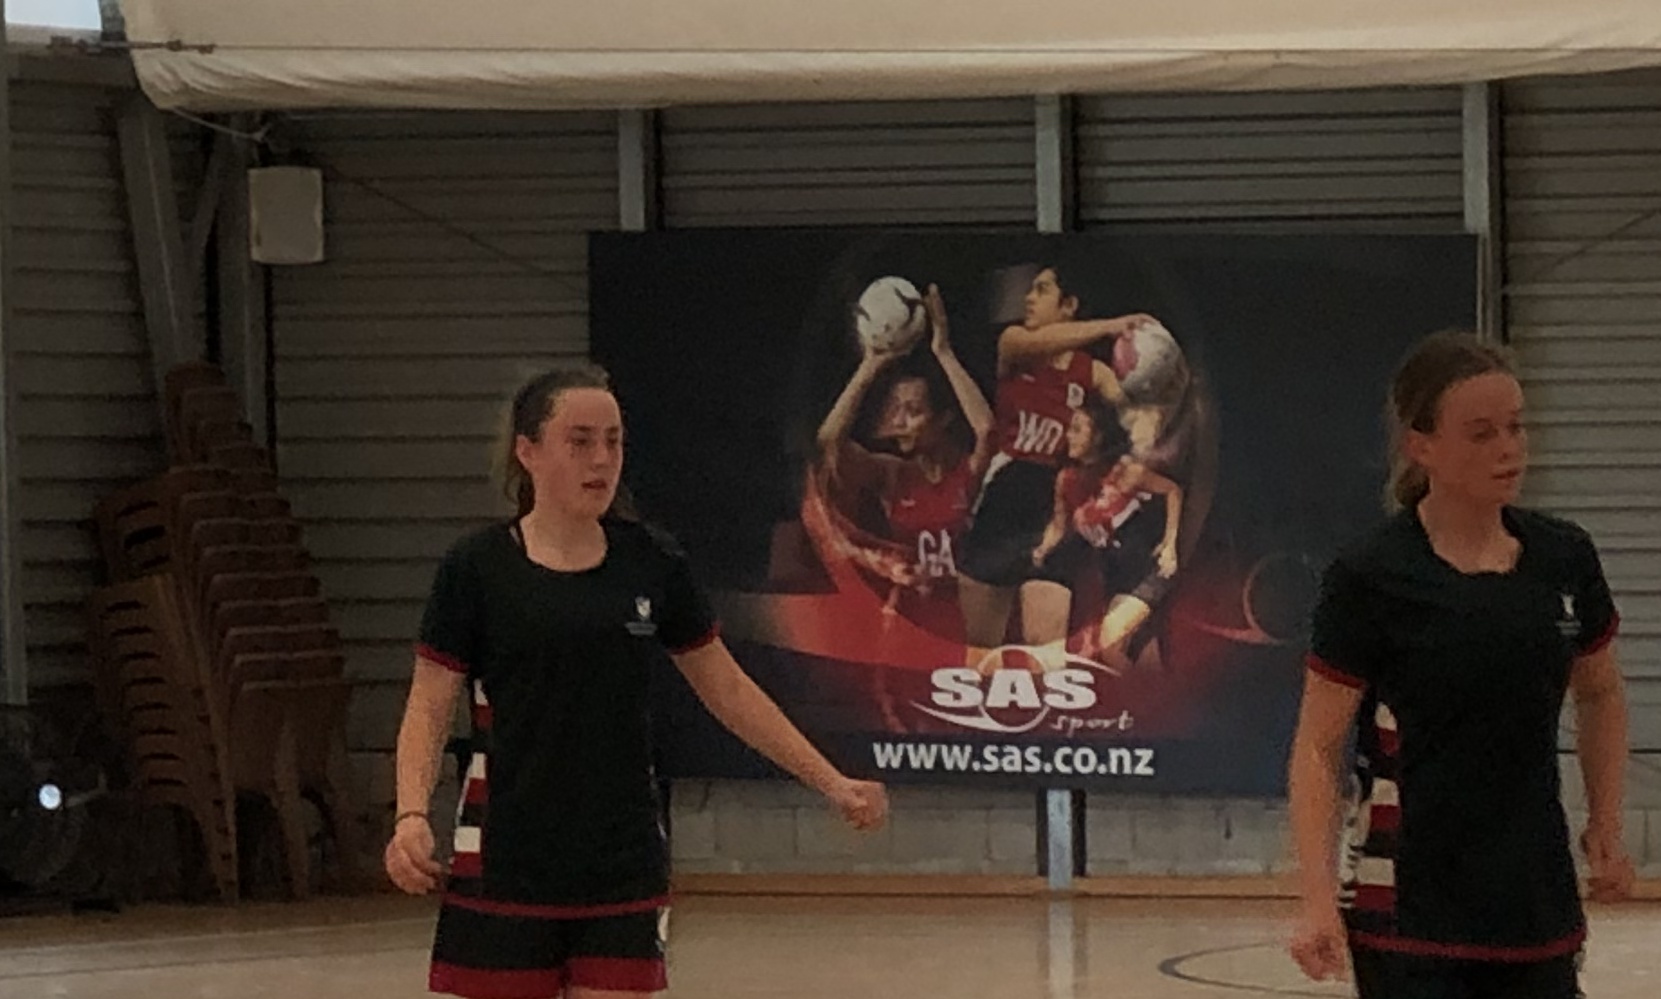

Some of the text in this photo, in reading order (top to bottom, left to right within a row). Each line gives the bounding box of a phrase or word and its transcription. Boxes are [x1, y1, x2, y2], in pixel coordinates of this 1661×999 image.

[918, 529, 958, 577] GA
[930, 667, 1097, 710] SAS
[1050, 710, 1134, 738] sport
[872, 741, 1155, 777] www.sas.co.nz
